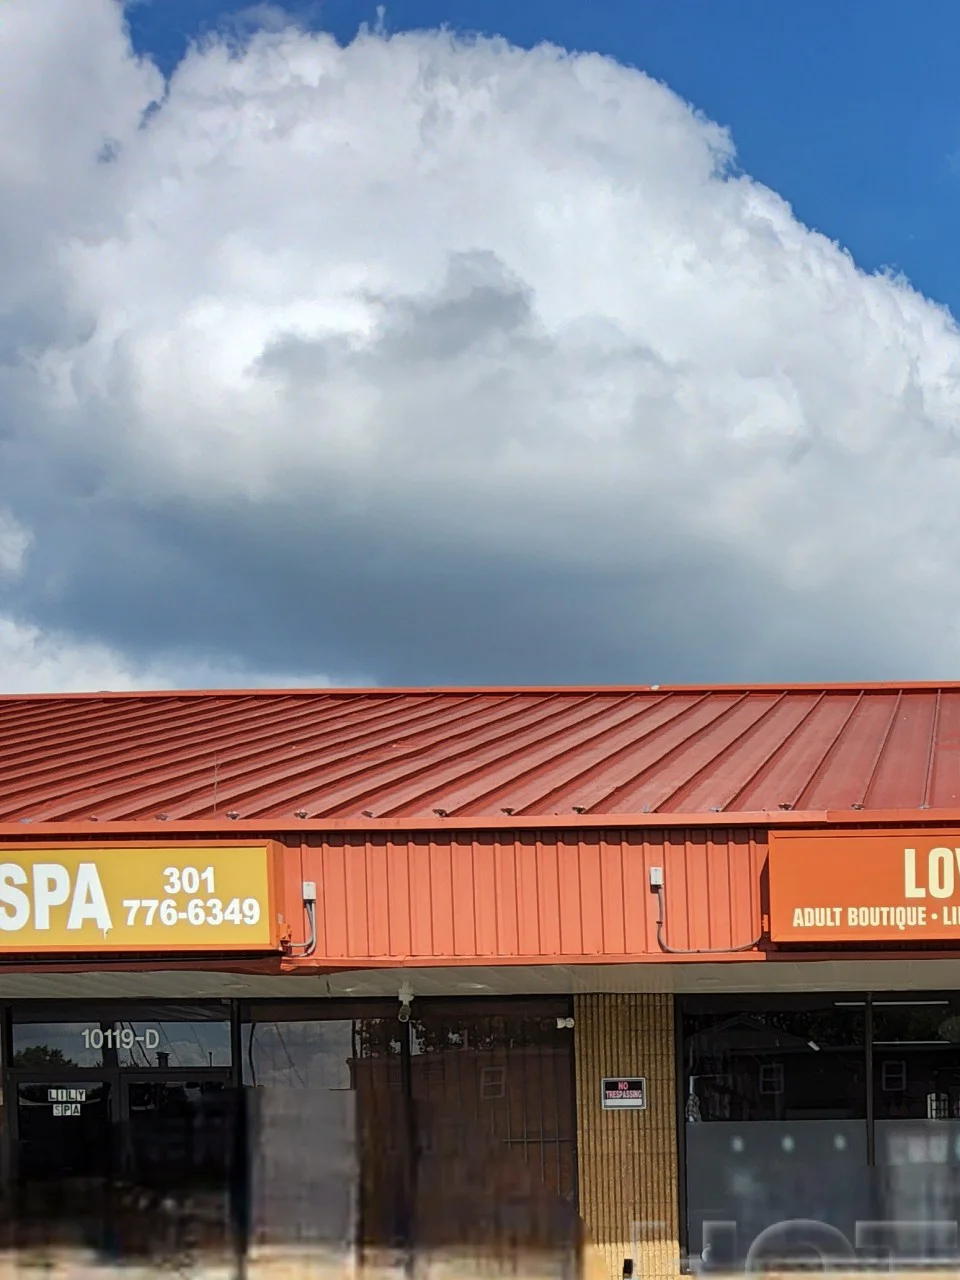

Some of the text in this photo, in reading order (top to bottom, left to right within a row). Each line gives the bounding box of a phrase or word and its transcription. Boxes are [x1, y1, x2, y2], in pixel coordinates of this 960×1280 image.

[163, 866, 215, 894] 301
[0, 862, 113, 931] SPA
[123, 898, 260, 926] 776-6349
[793, 907, 842, 927] ADULT
[847, 906, 927, 930] BOUTIQUE
[82, 1029, 160, 1049] 10119-D
[48, 1089, 86, 1101] LILY
[606, 1090, 642, 1098] TRESPASSING
[618, 1082, 628, 1090] NO
[53, 1104, 81, 1117] SPA
